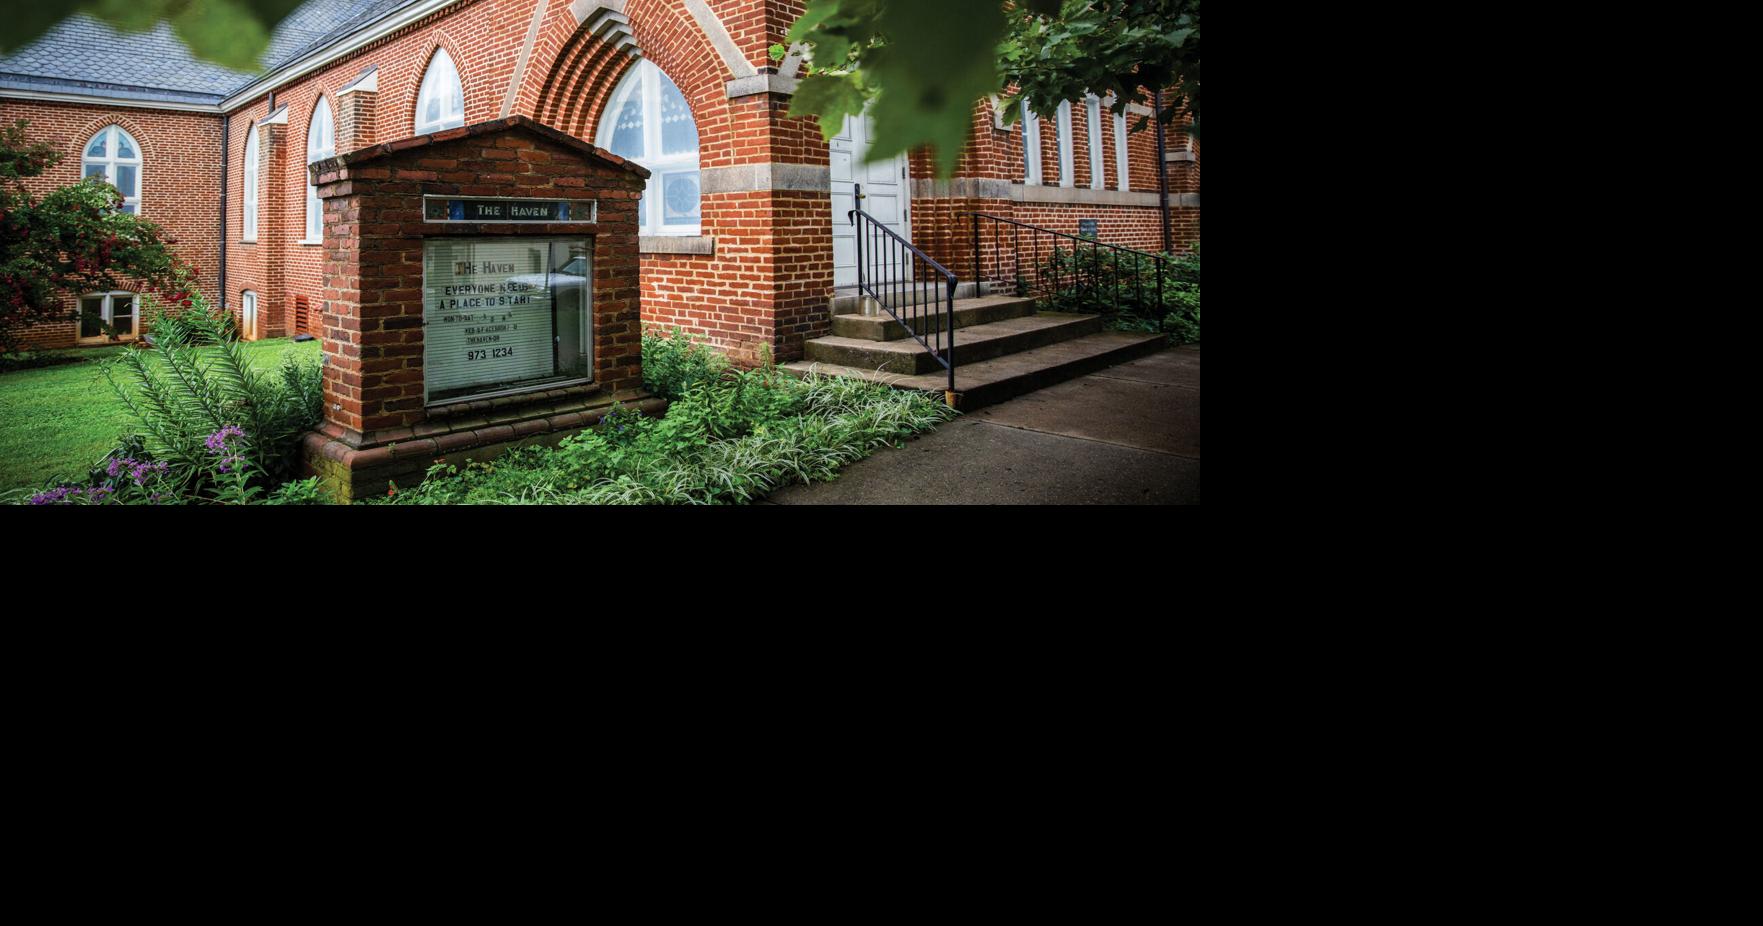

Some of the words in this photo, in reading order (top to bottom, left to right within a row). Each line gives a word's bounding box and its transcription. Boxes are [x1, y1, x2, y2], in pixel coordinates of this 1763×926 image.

[477, 205, 500, 216] THE
[511, 206, 548, 217] HAVEN
[483, 261, 515, 274] HAVEN
[445, 284, 496, 296] EVERYONE
[440, 300, 445, 310] A
[450, 298, 481, 309] PLACE
[485, 297, 496, 307] TO
[468, 350, 487, 361] 973
[492, 346, 513, 359] 1234
